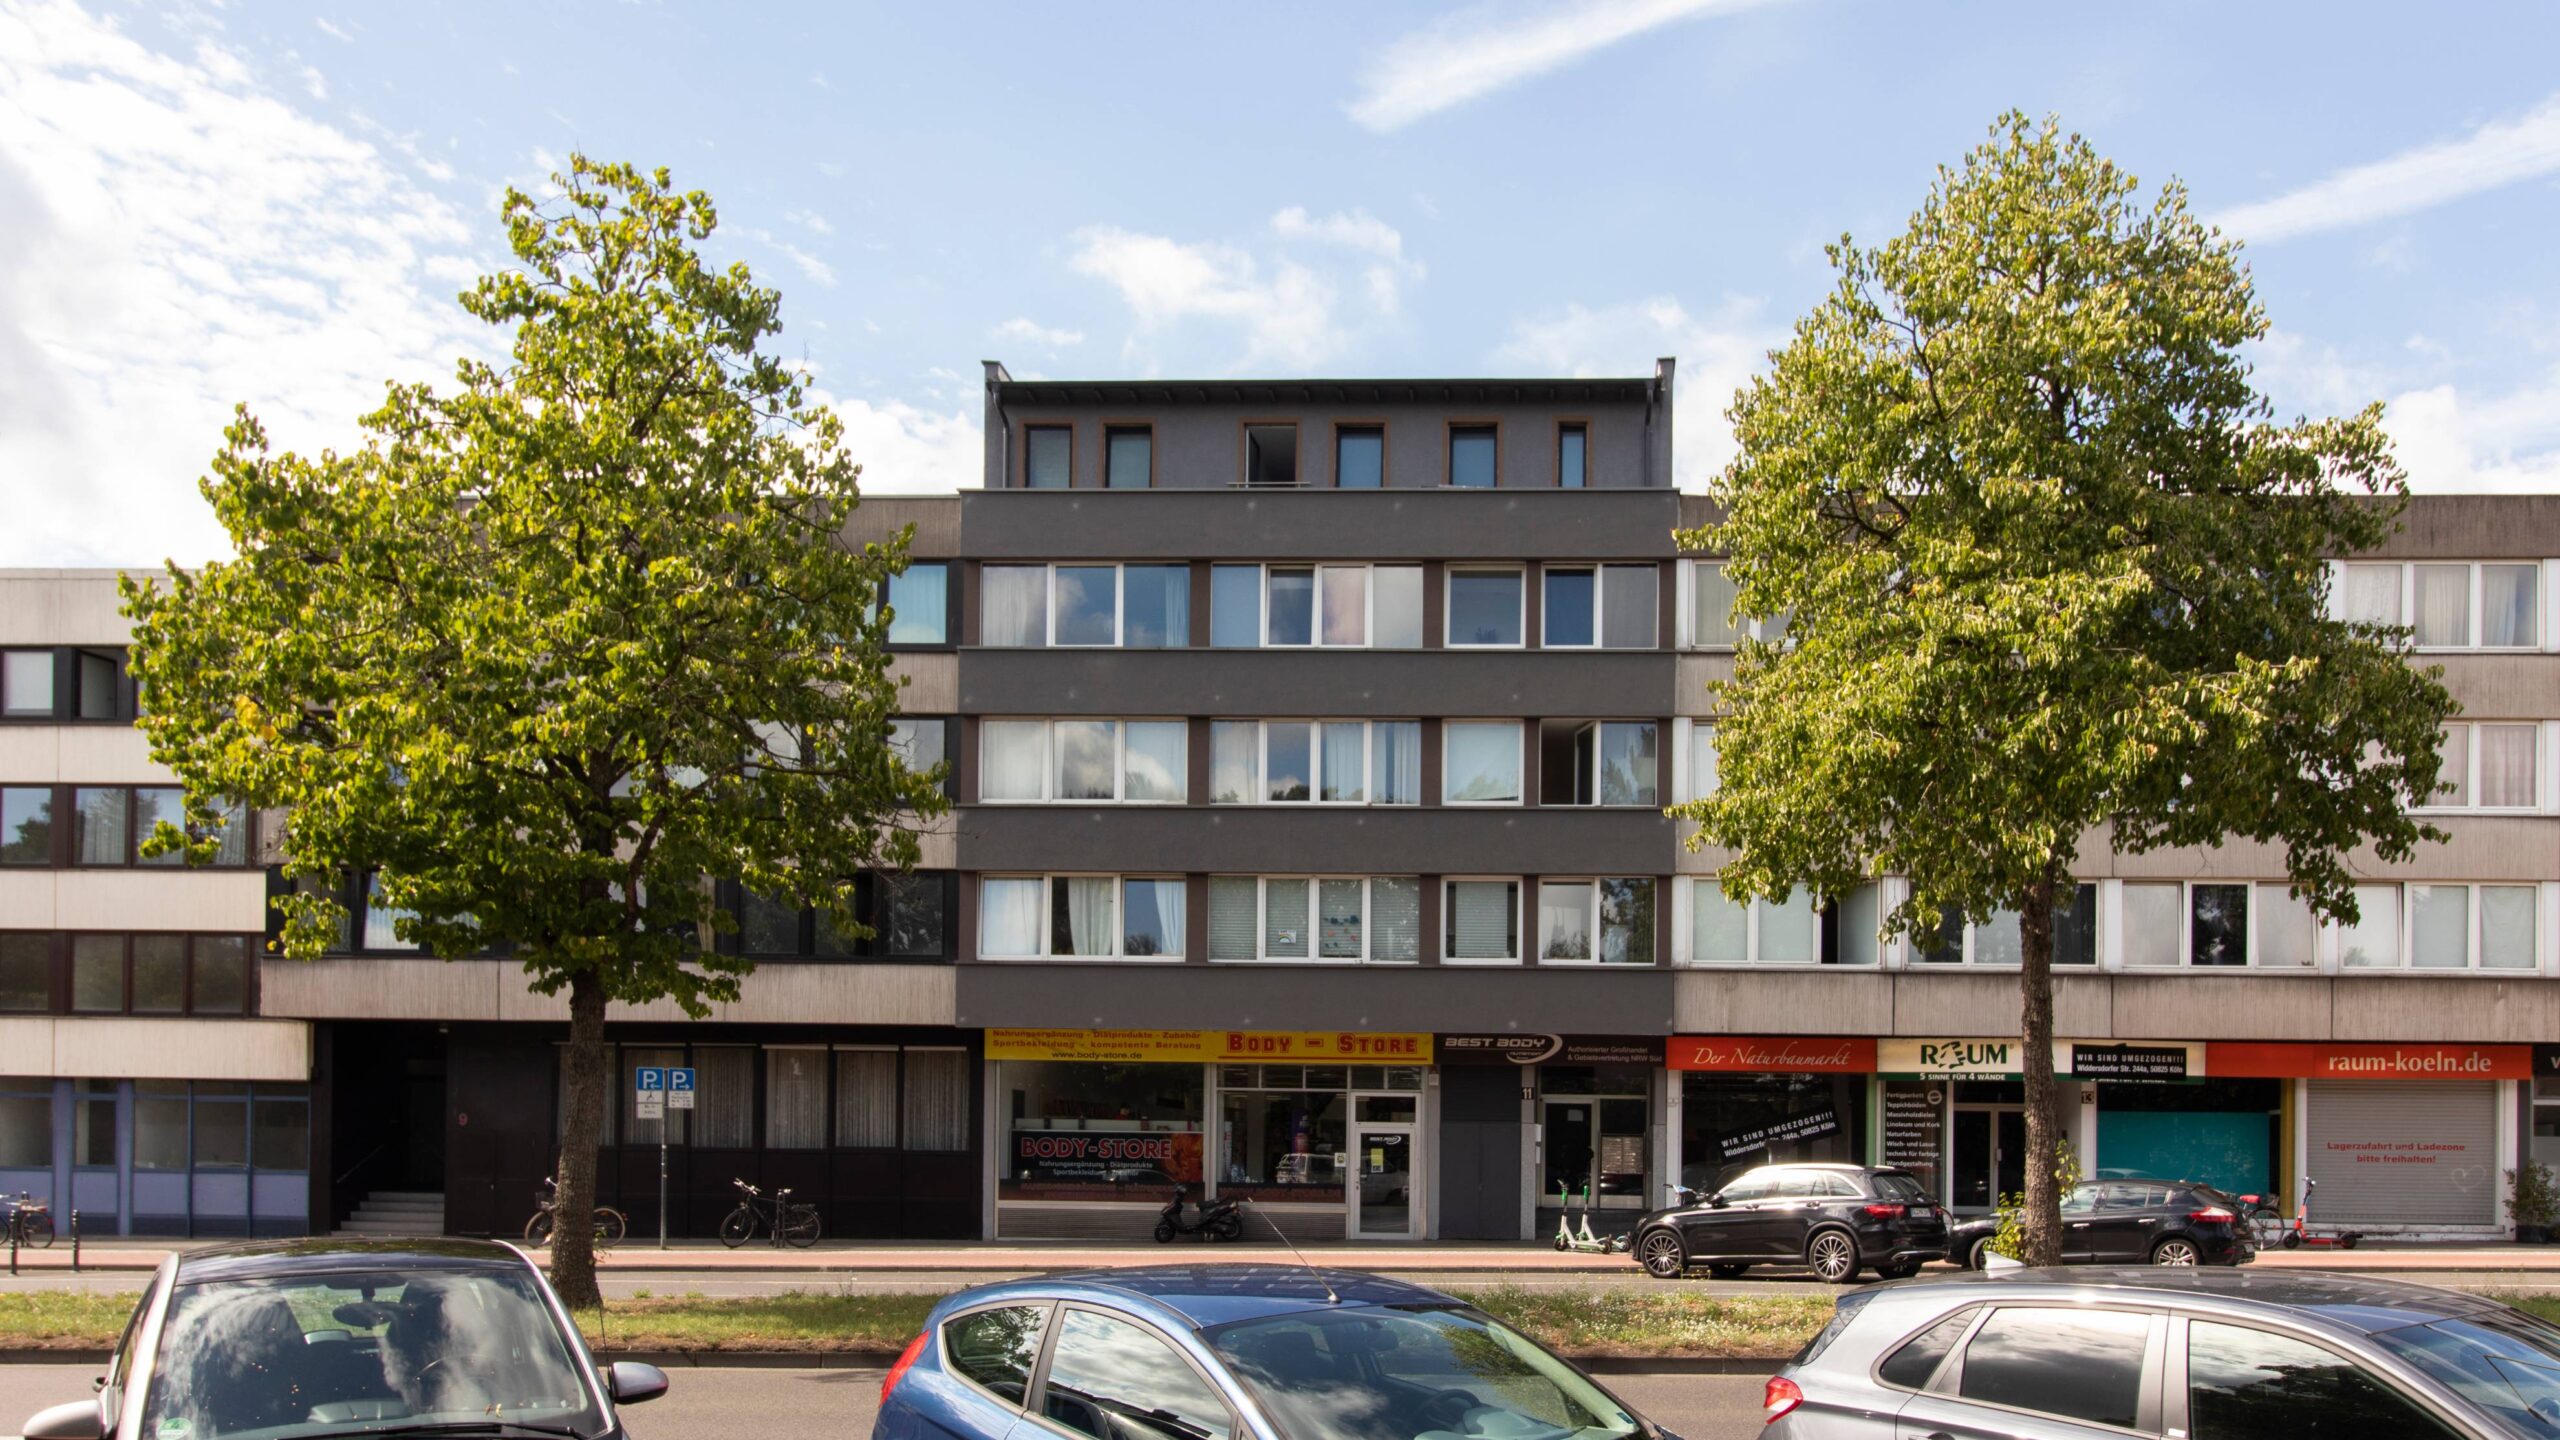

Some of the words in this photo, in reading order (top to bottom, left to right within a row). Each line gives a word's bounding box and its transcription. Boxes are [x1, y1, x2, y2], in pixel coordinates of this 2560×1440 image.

[993, 1040, 1074, 1048] Sportbekleidung
[1156, 1042, 1201, 1050] Beratung
[1445, 1038, 1494, 1047] BEST
[1496, 1038, 1546, 1047] BODY
[1051, 1051, 1142, 1059] www.body-store.de
[1694, 1048, 1725, 1065] Der
[1730, 1041, 1851, 1066] Naturbaumarkt
[2077, 1054, 2093, 1062] WIR
[2121, 1055, 2184, 1063] UMGEZOGEN!!!
[2328, 1051, 2492, 1072] raum-koeln.de
[2077, 1064, 2119, 1072] Widdersdorfer
[643, 1070, 658, 1089] P
[672, 1071, 687, 1089] P
[1523, 1088, 1532, 1099] 11
[1721, 1137, 1739, 1148] WIR
[1742, 1130, 1764, 1142] SIND
[1767, 1111, 1833, 1135] UMGEZOGEN!!!
[1724, 1140, 1767, 1157] Widdersdorfe
[1820, 1121, 1835, 1131] Köln
[1021, 1137, 1171, 1159] BODY-STORE
[2327, 1142, 2392, 1151] Lagerzufahrt
[2417, 1143, 2465, 1151] Ladezone
[2383, 1155, 2436, 1163] freihalten!
